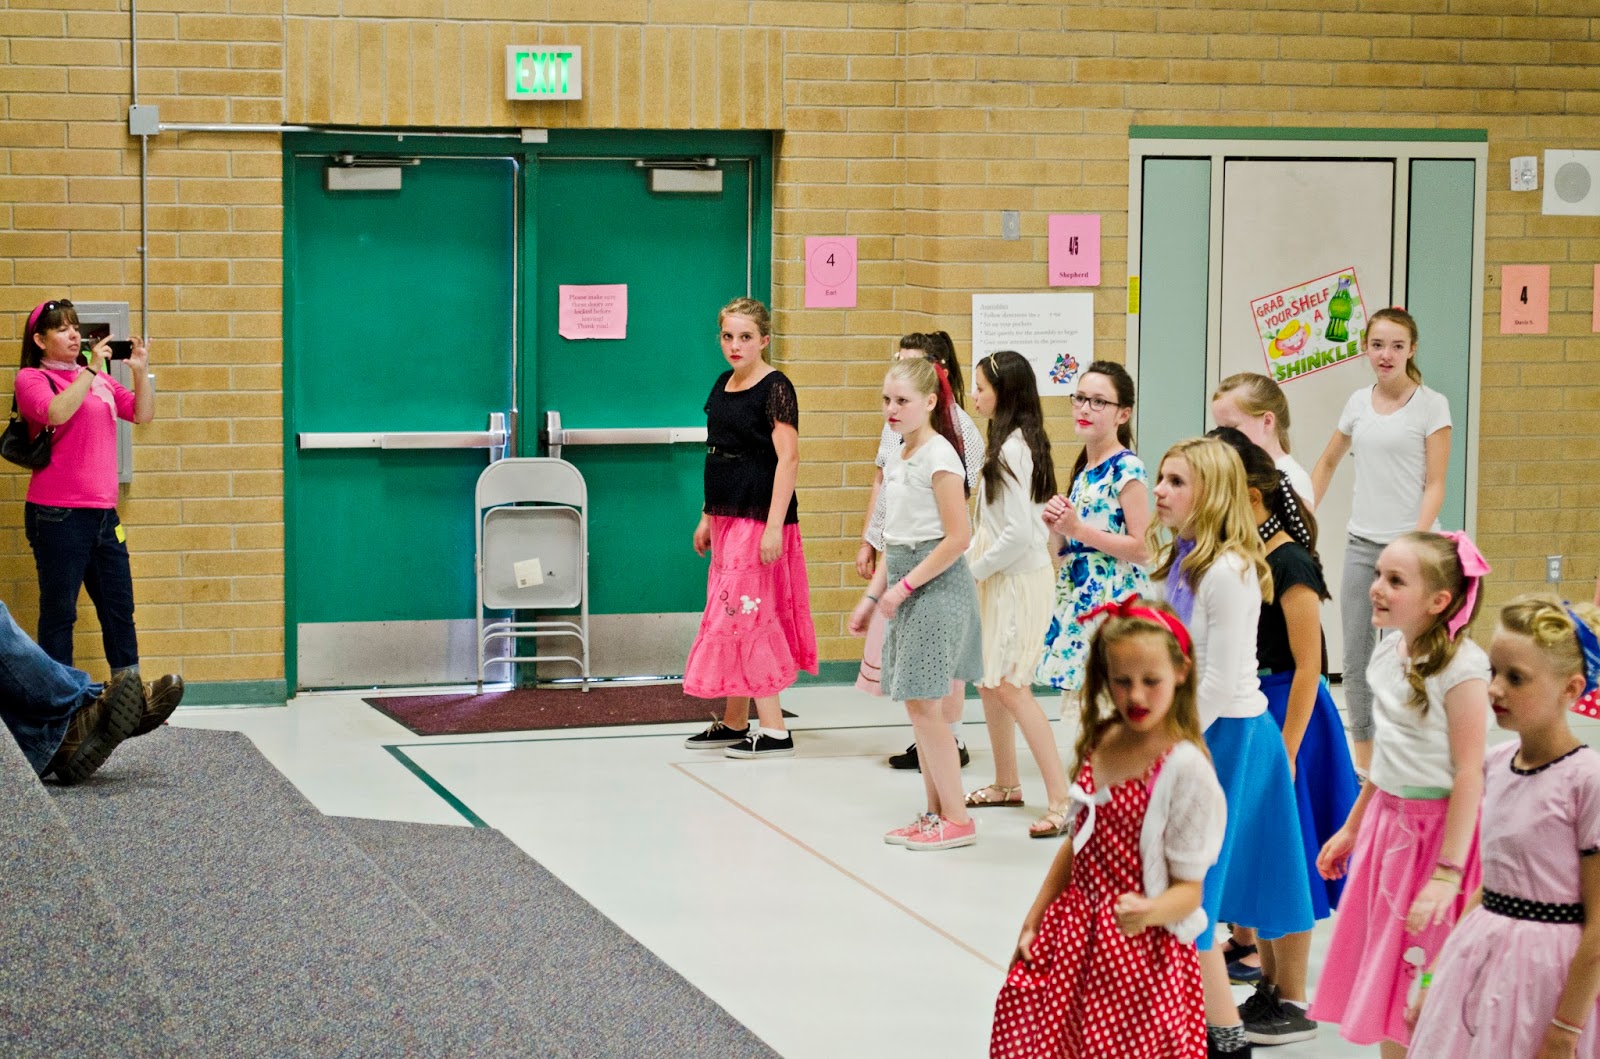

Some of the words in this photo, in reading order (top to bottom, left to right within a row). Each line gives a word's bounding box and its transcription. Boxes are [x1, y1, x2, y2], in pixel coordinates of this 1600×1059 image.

[515, 52, 573, 94] EXIT
[826, 253, 836, 267] 4
[1059, 271, 1089, 279] Shepherd
[1520, 285, 1528, 305] 4
[1256, 295, 1285, 318] GRAB
[1265, 308, 1293, 329] YOUR
[1290, 287, 1330, 317] SHELF
[1314, 308, 1324, 324] A
